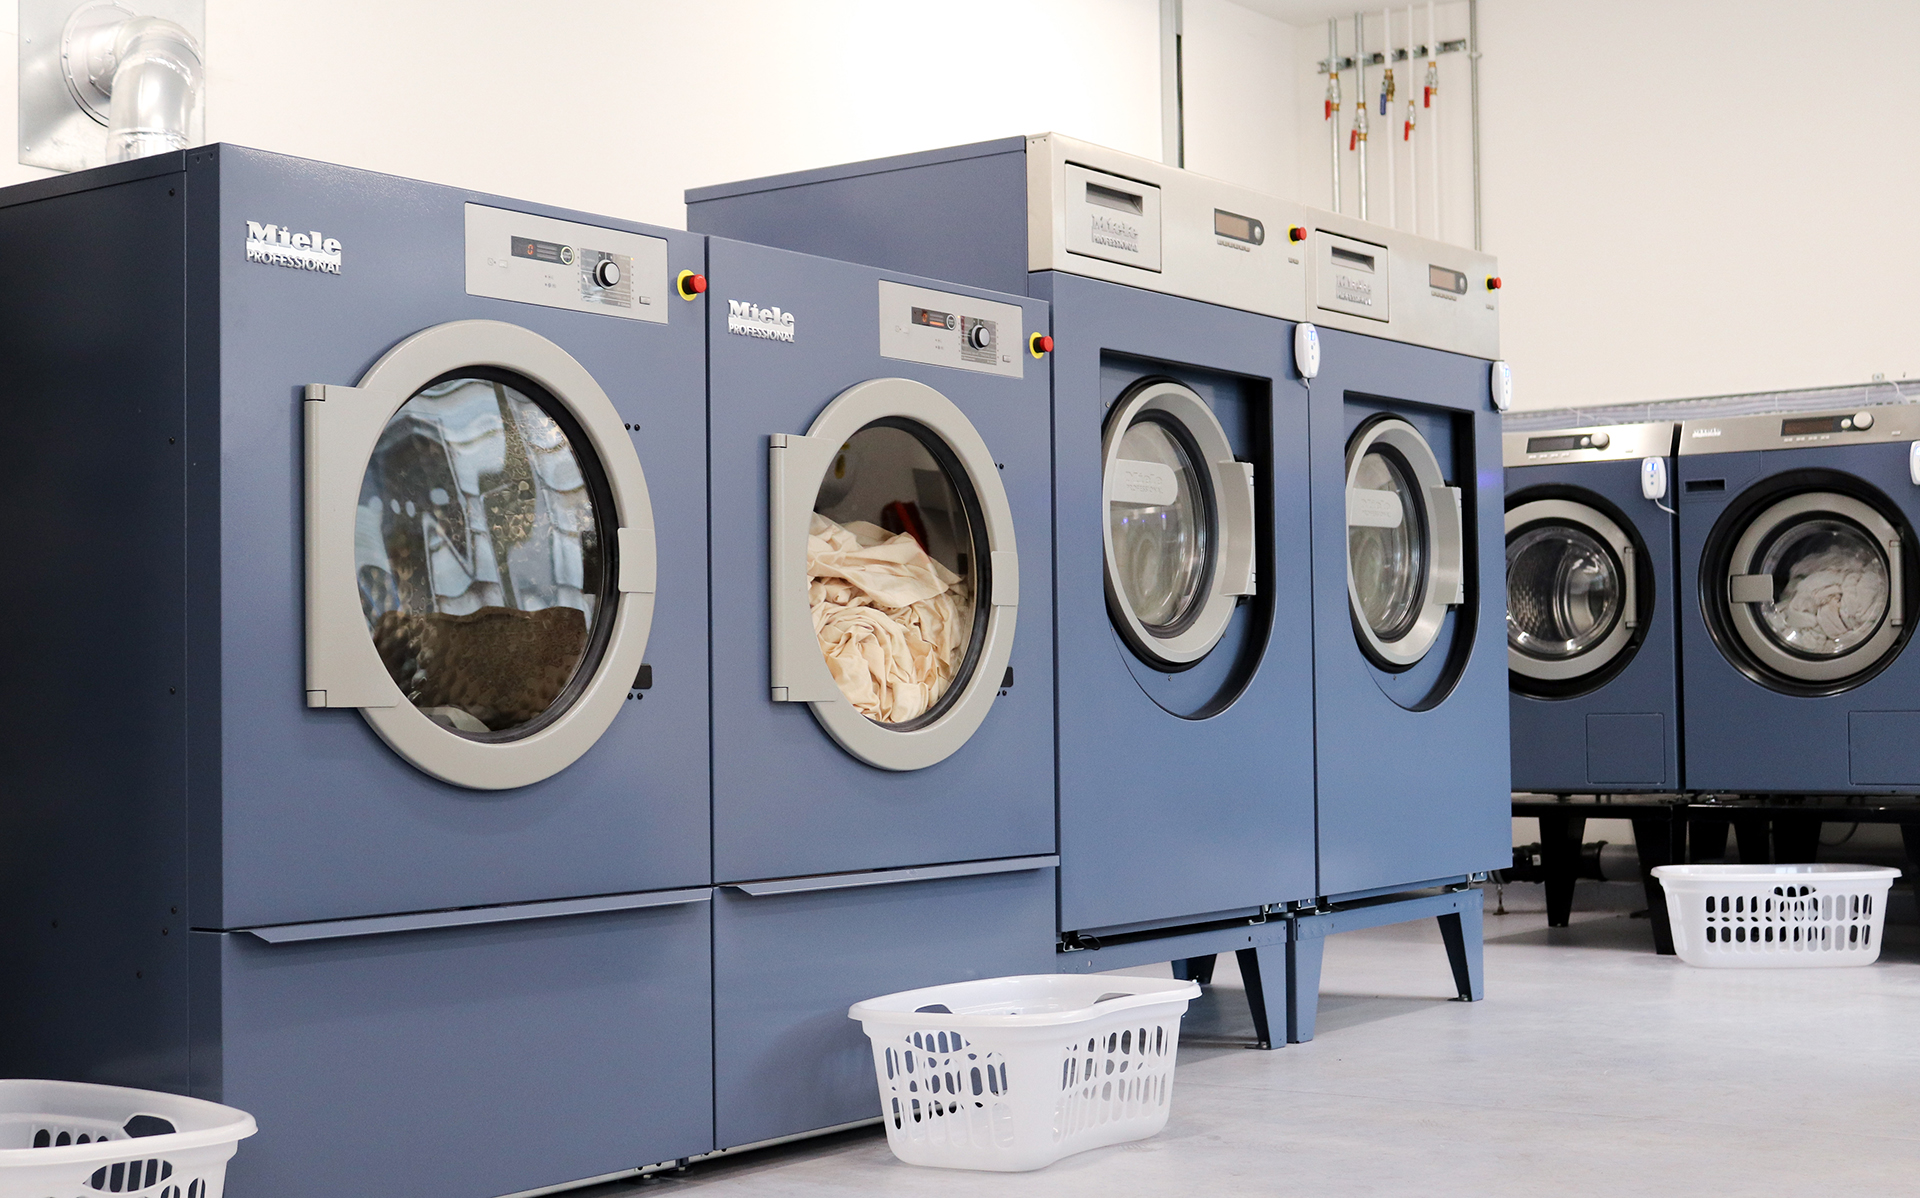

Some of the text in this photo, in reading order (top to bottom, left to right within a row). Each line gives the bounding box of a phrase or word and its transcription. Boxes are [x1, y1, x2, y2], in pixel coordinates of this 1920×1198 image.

[246, 220, 342, 256] Miele
[246, 248, 342, 275] PROFESSIONAL
[728, 299, 795, 327] Miele
[728, 323, 795, 343] PROFESSIONAL
